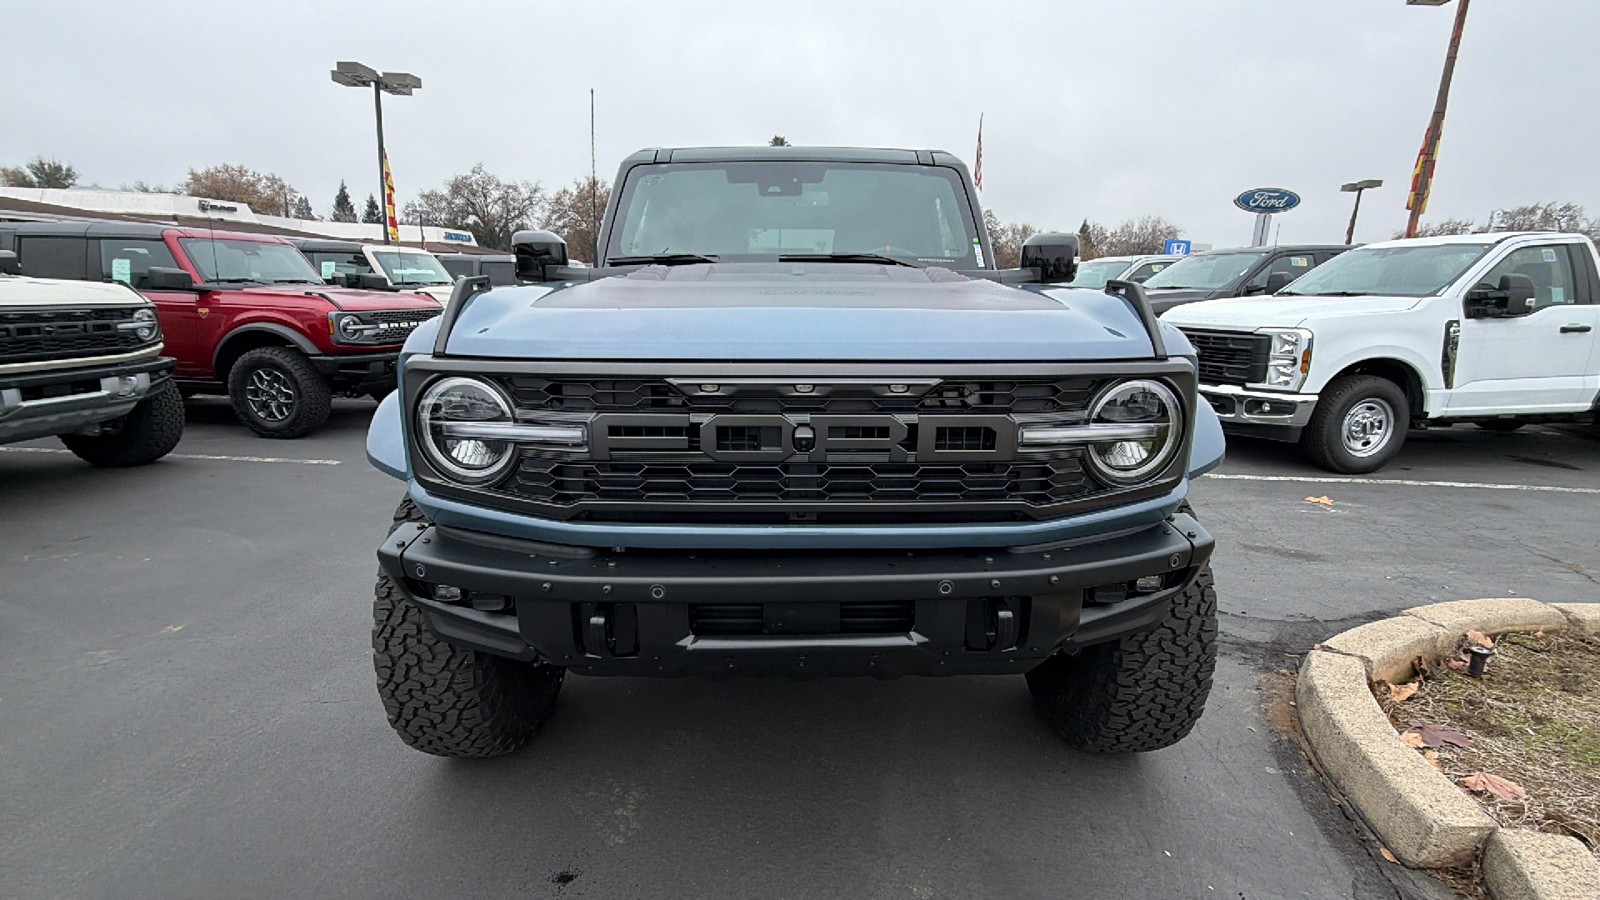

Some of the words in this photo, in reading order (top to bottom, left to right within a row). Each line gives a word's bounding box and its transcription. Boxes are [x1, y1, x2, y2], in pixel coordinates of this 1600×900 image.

[1249, 191, 1289, 208] Ford
[379, 321, 424, 329] BRON
[591, 413, 1017, 462] FORD
